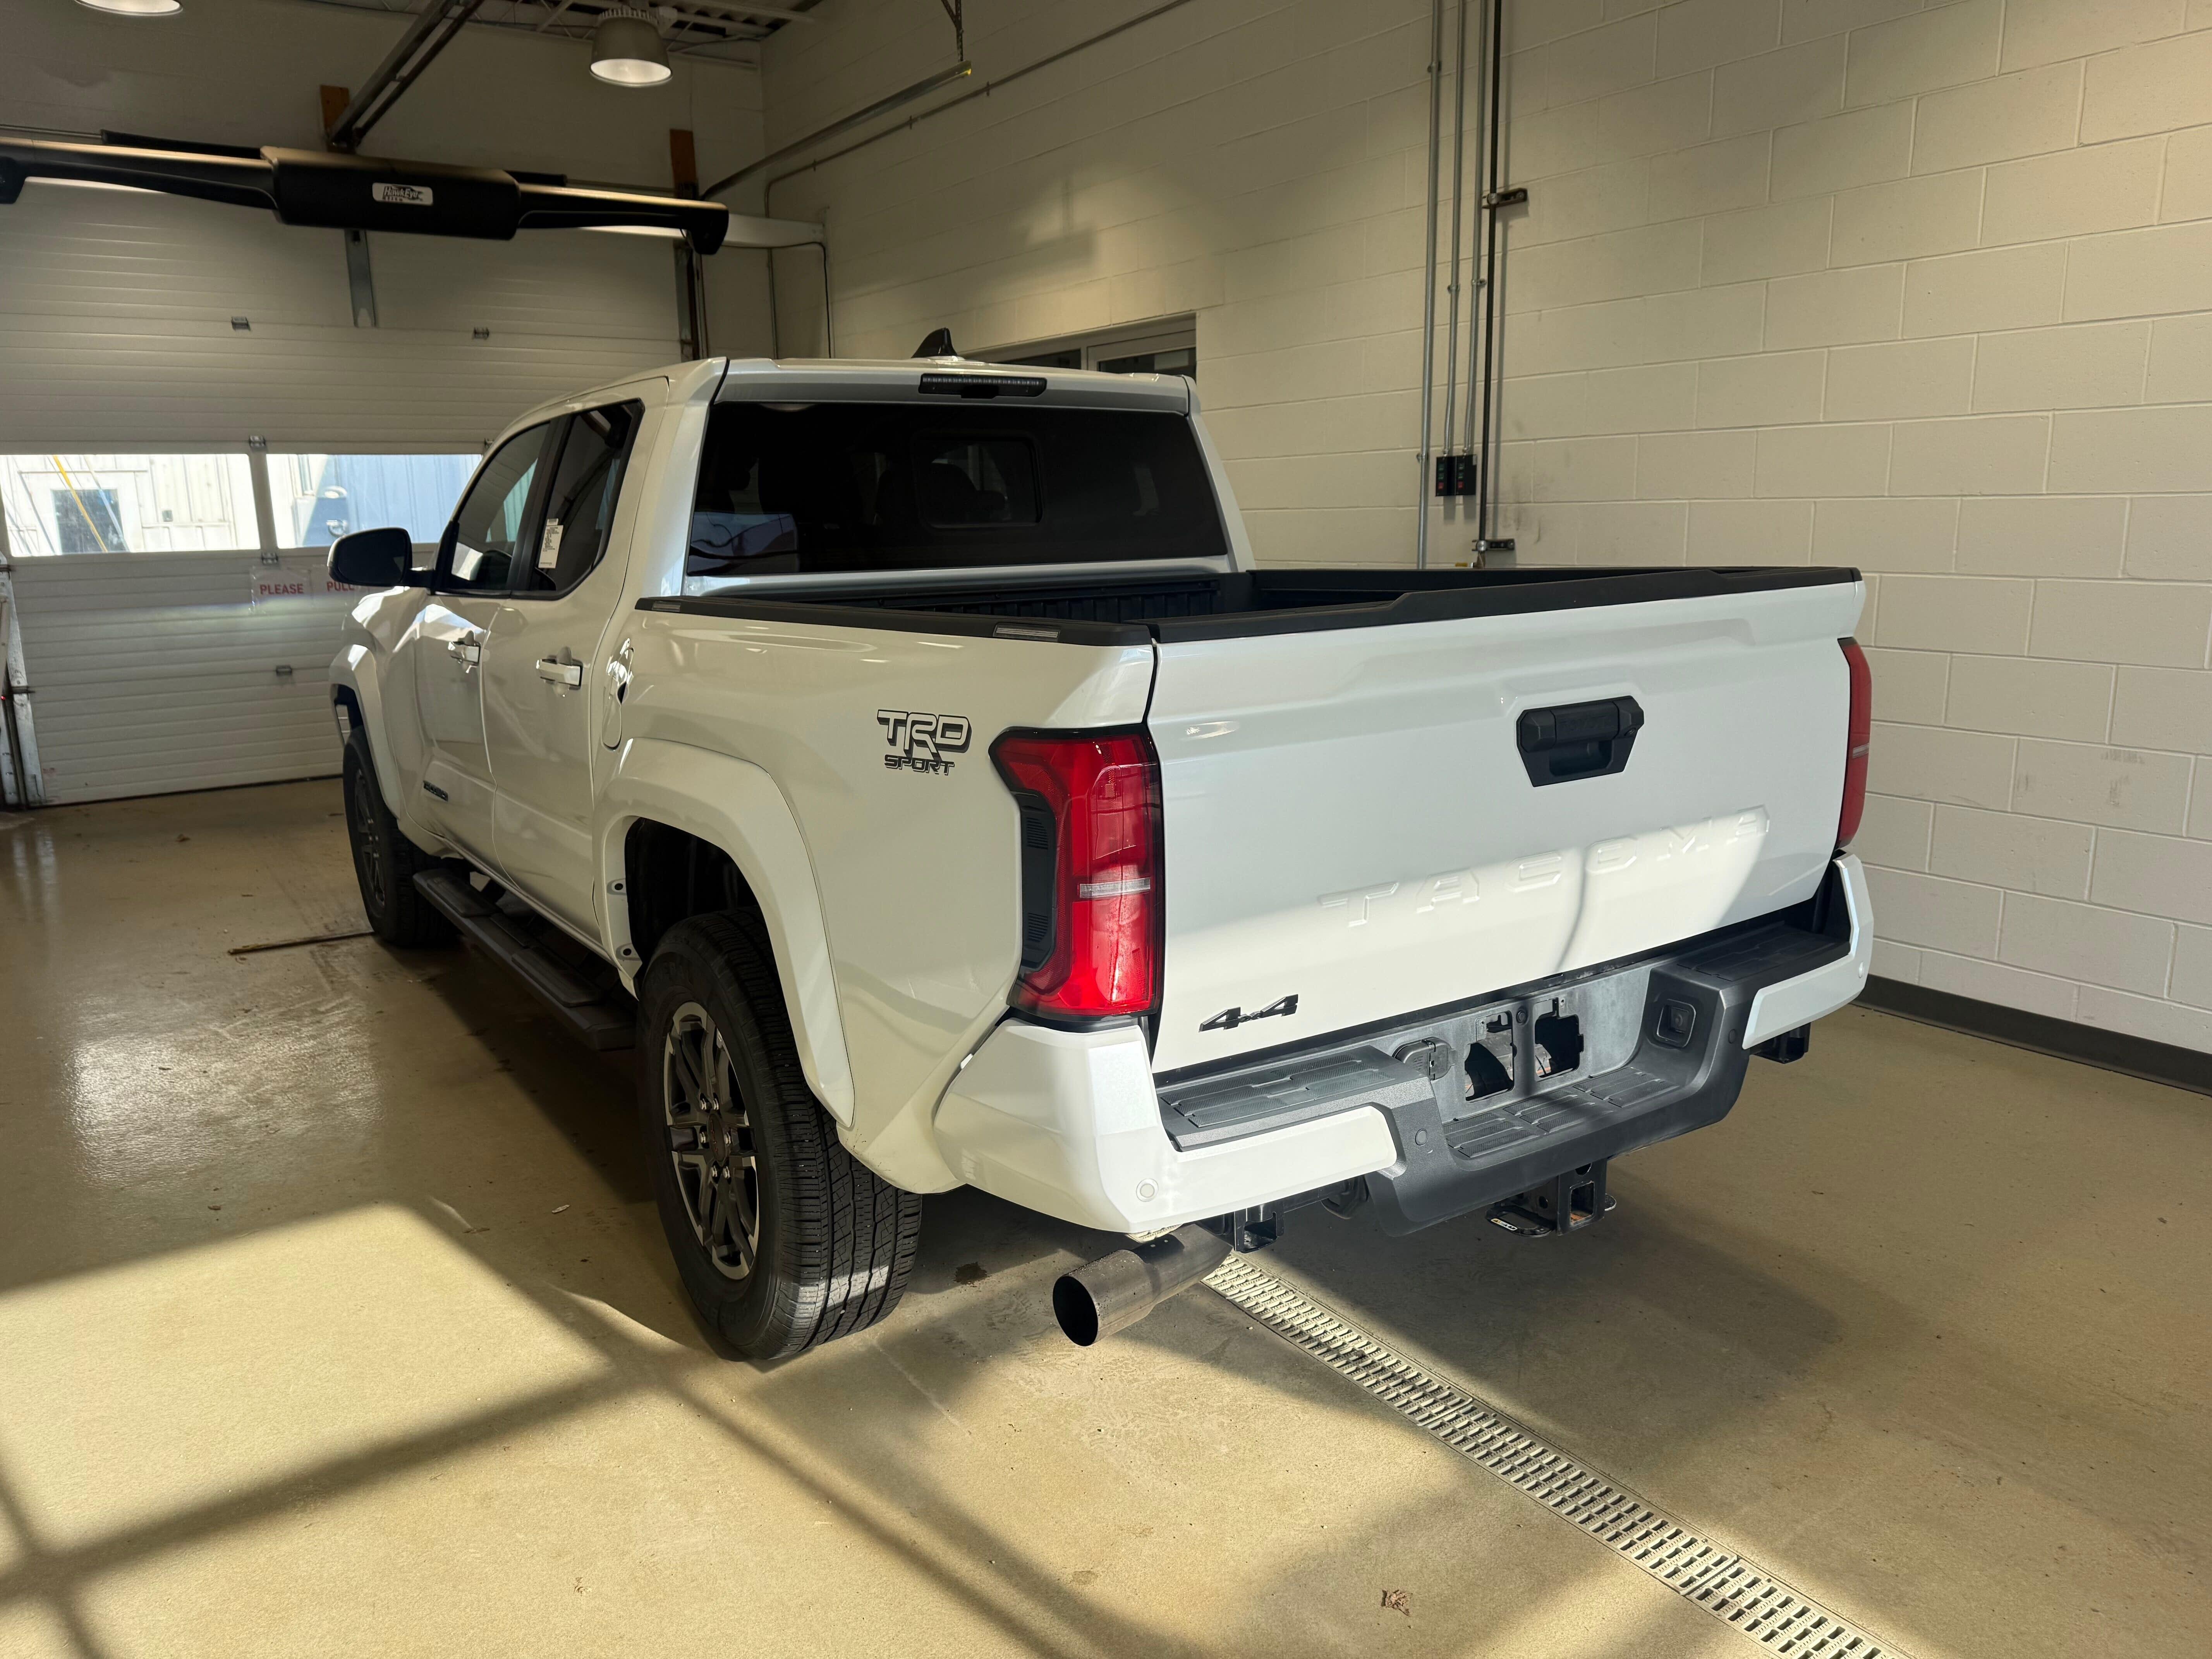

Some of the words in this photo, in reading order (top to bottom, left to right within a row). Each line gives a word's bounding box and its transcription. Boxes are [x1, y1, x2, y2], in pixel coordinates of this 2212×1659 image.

[260, 583, 304, 594] PLEASE
[326, 581, 355, 592] PULL
[877, 709, 972, 761] TRD
[884, 754, 955, 776] SPORT
[1317, 804, 1770, 927] TACOMA
